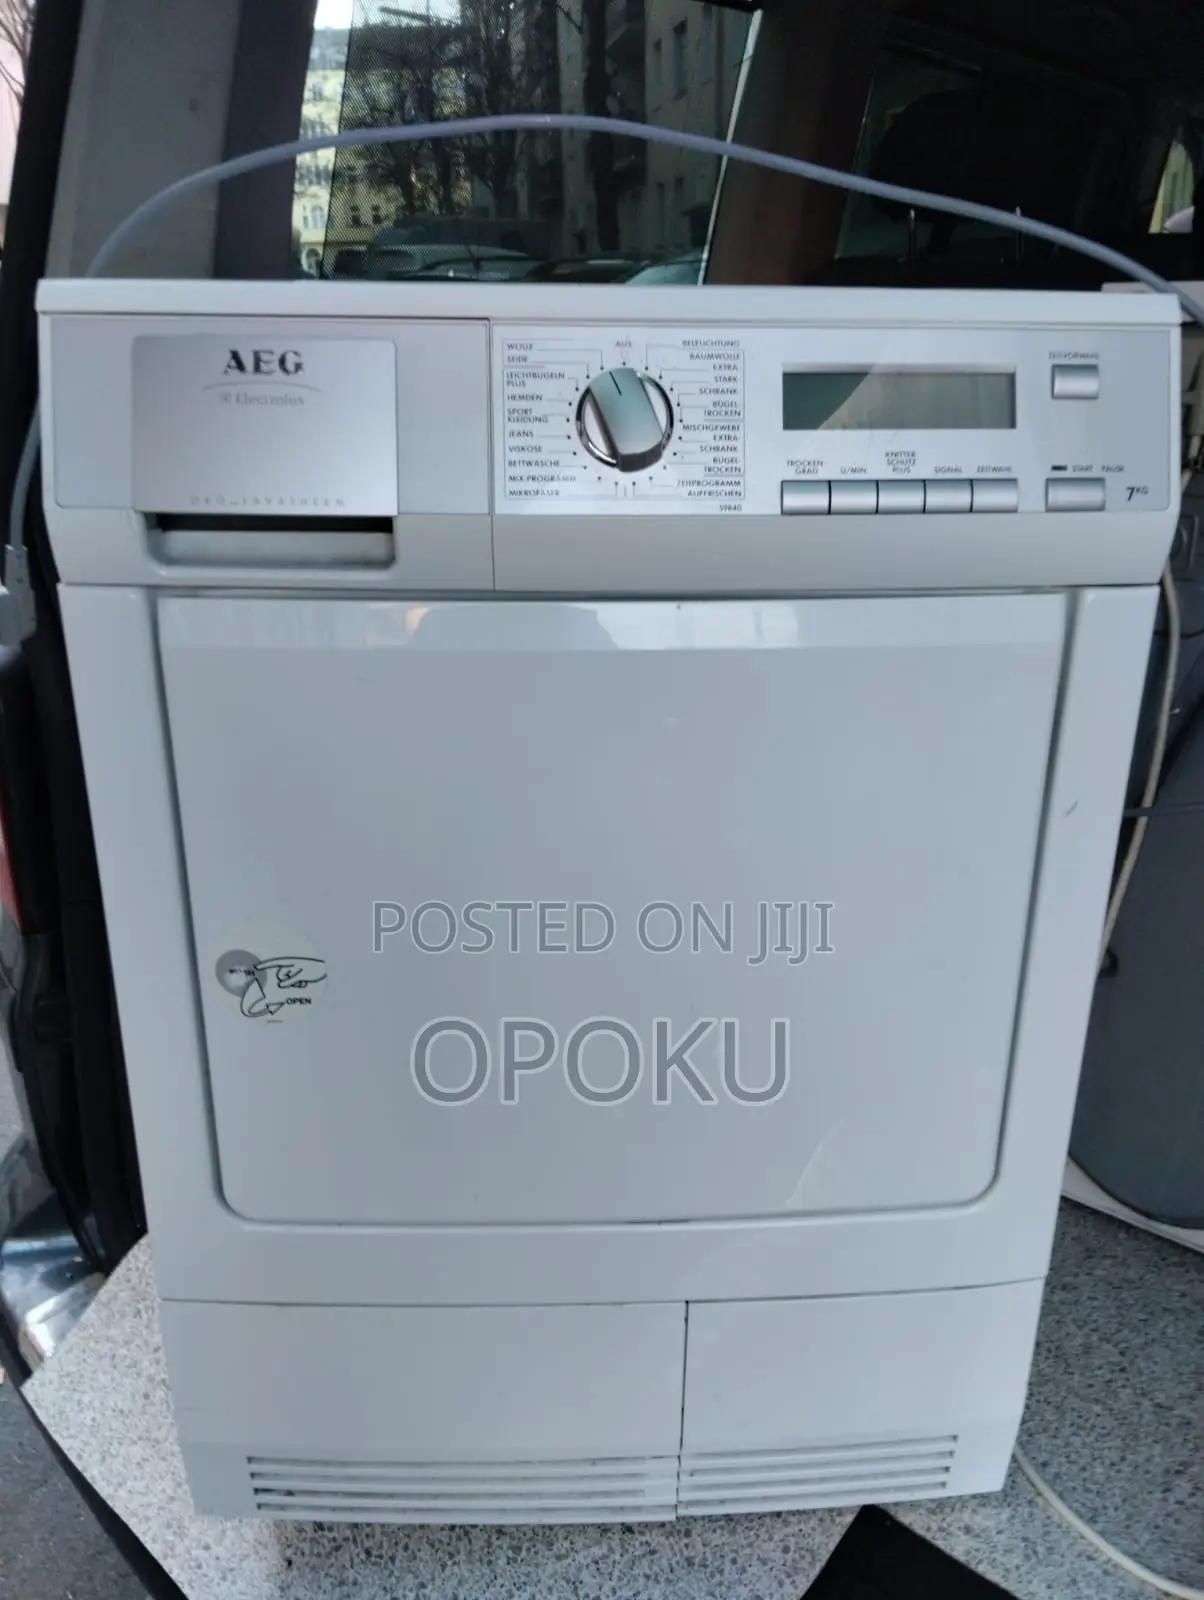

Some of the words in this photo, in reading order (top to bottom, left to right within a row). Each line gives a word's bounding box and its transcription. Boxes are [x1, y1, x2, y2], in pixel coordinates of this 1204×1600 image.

[682, 339, 740, 348] BELEUCHTUNG
[689, 352, 740, 361] BAUMWOLLE
[223, 349, 304, 376] AEG
[712, 363, 738, 371] EXTRA
[714, 375, 738, 383] STARK
[506, 380, 526, 388] PLUS
[698, 387, 738, 396] SCHRANK
[507, 393, 543, 401] HEMDEN
[507, 407, 532, 415] SPORT
[704, 409, 741, 417] TROCKEN
[507, 415, 549, 424] KLEIDUNG
[682, 423, 740, 431] MISCHGEWEBE
[508, 430, 534, 438] JEANS
[508, 445, 543, 453] VISKOSE
[699, 444, 738, 453] SCHRANK
[885, 451, 916, 459] KNITTER
[787, 459, 823, 468] TROCKEN
[886, 458, 917, 466] SCHUTZ
[795, 467, 818, 475] GRAD
[934, 466, 964, 474] SIGNAL
[509, 489, 560, 497] MIKROFASER
[286, 997, 312, 1005] OPEN
